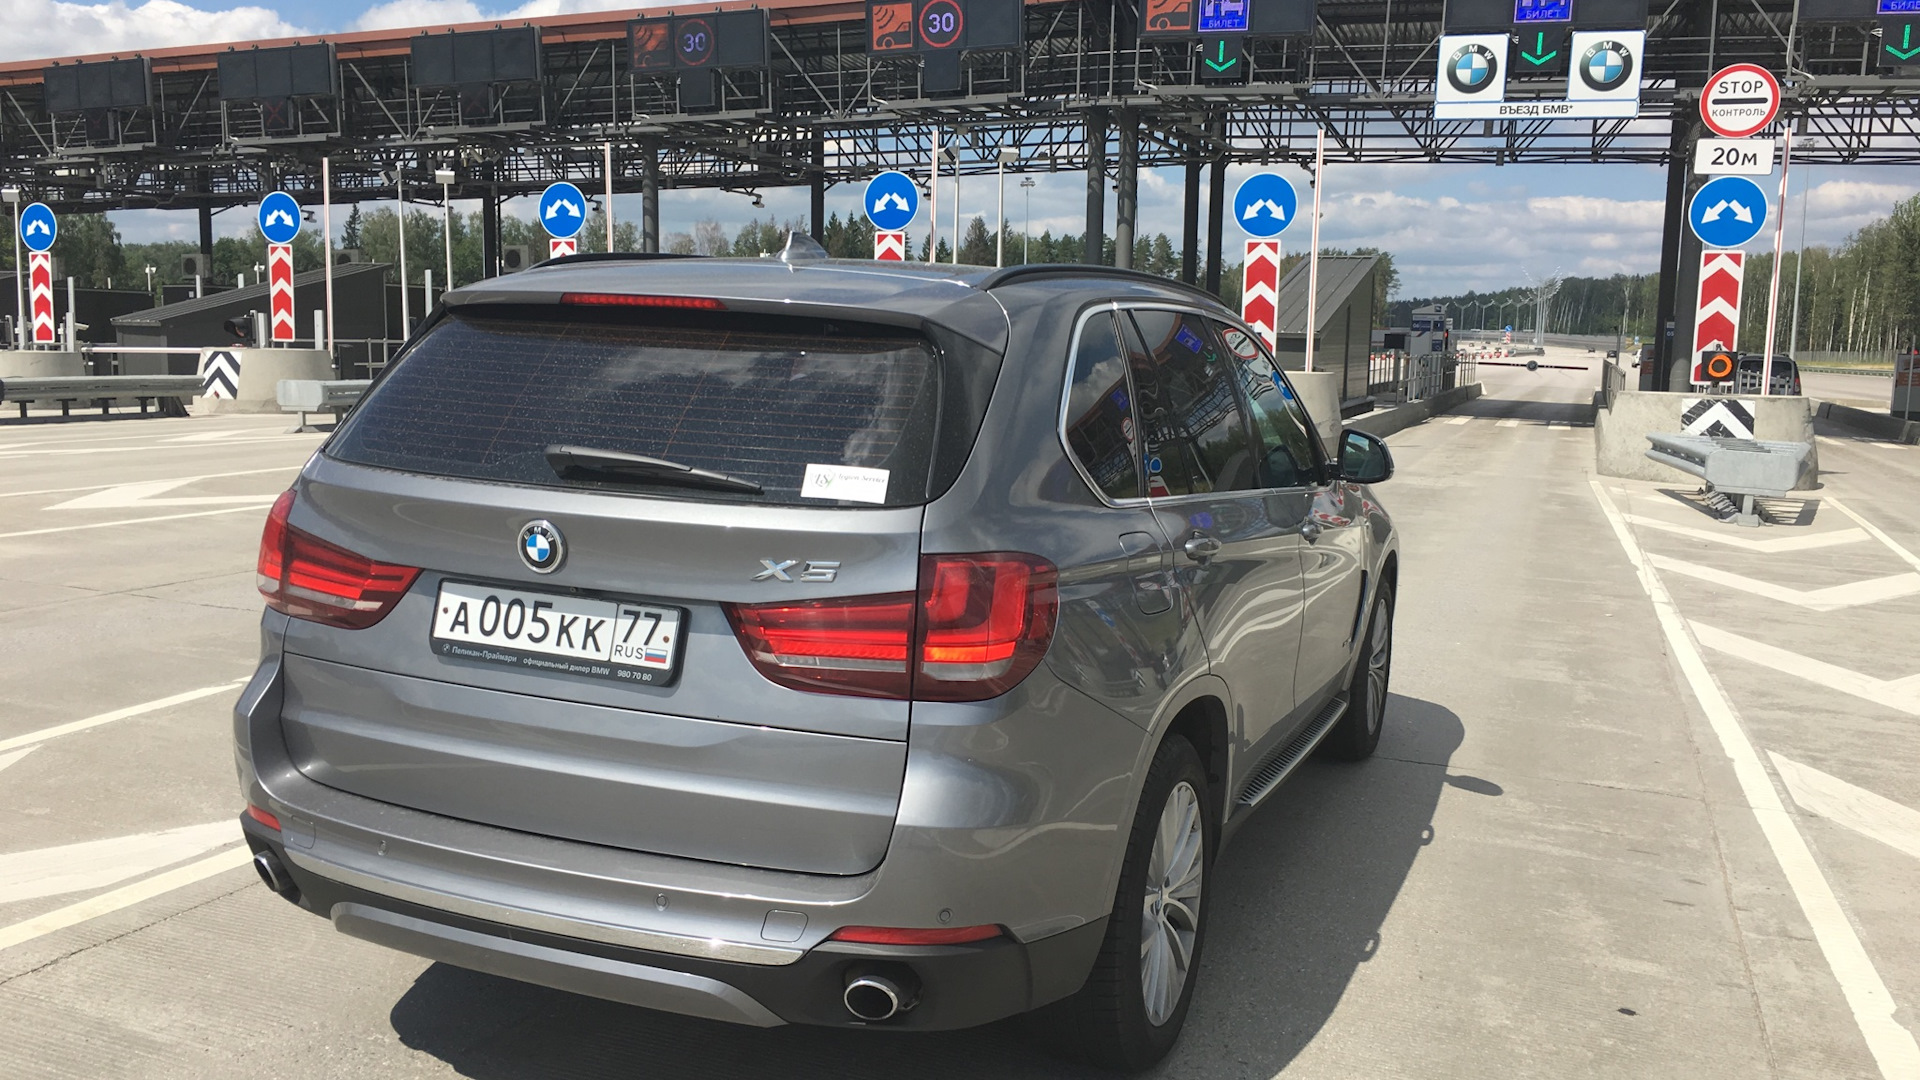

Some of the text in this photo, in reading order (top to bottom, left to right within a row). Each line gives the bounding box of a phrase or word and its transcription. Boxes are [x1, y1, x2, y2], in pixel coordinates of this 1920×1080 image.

[1525, 9, 1562, 19] БИЛЕТ
[928, 12, 955, 34] 30
[1208, 19, 1240, 28] БИЛЕТ
[683, 32, 706, 53] 30
[1586, 41, 1629, 58] BMW
[1453, 44, 1493, 60] BMW
[1718, 80, 1764, 94] STOP
[1499, 105, 1539, 116] ВЪЕЗД
[1711, 108, 1766, 117] КОНТРОЛЬ
[523, 526, 554, 542] BMW
[750, 558, 841, 582] X5
[622, 609, 663, 646] 77
[614, 644, 644, 660] RUS
[452, 646, 652, 681] Пеликан-Праймари официальный дилер BMW 980 70 80
